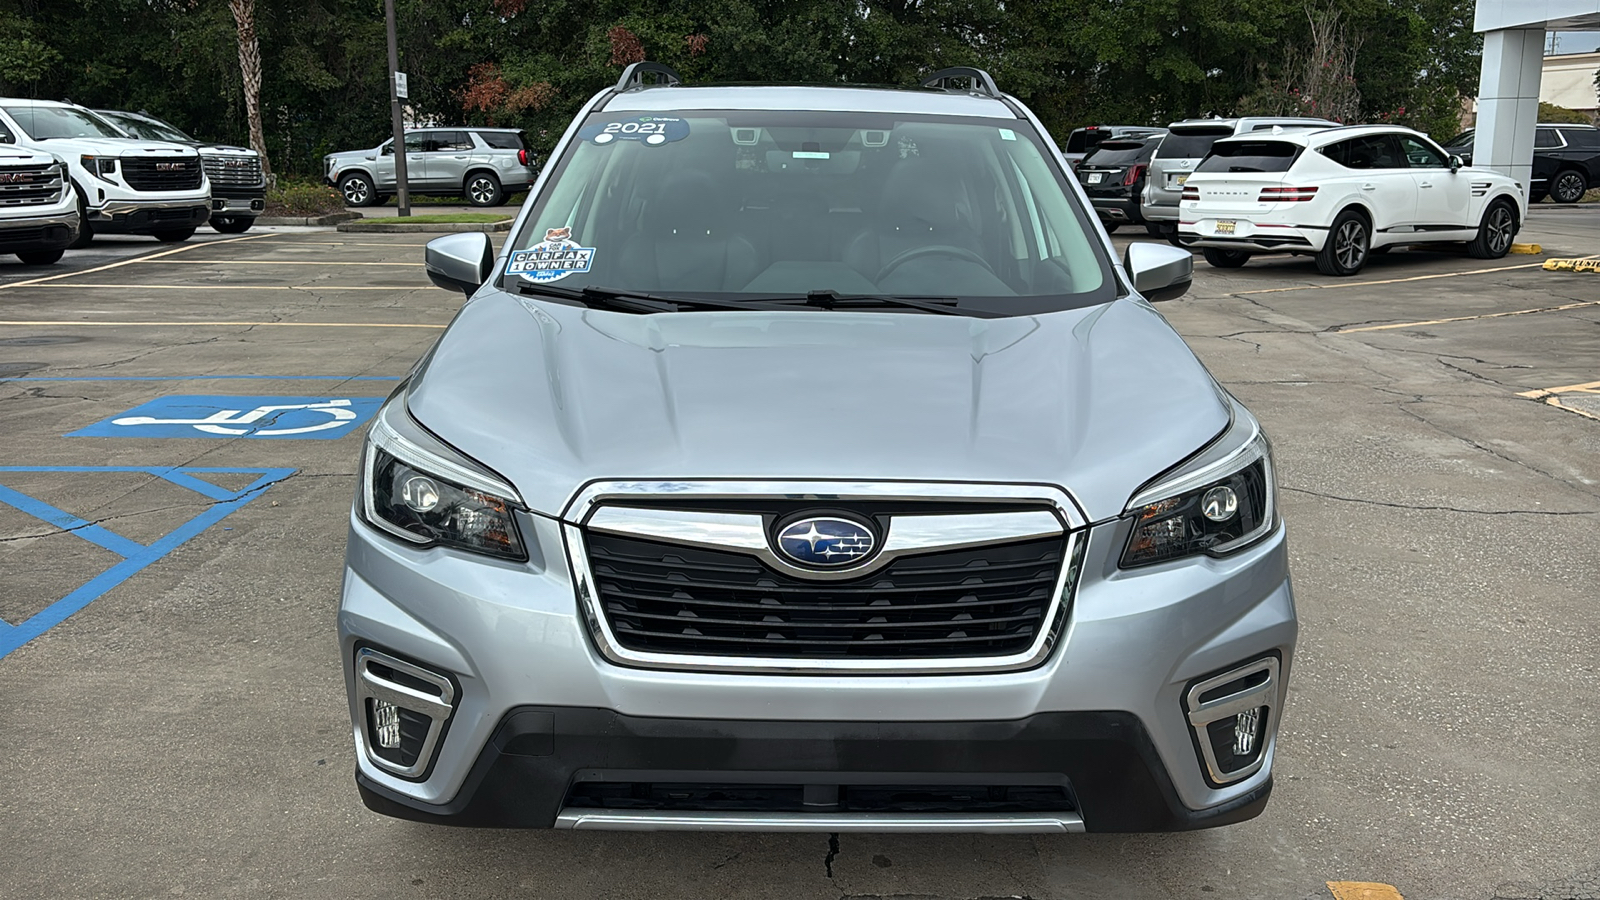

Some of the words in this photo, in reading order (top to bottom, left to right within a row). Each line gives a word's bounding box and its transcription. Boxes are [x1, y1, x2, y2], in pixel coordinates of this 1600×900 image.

[603, 122, 666, 134] 2021
[156, 162, 186, 171] GMC
[515, 251, 588, 262] CARFAX
[525, 261, 585, 270] OWNER
